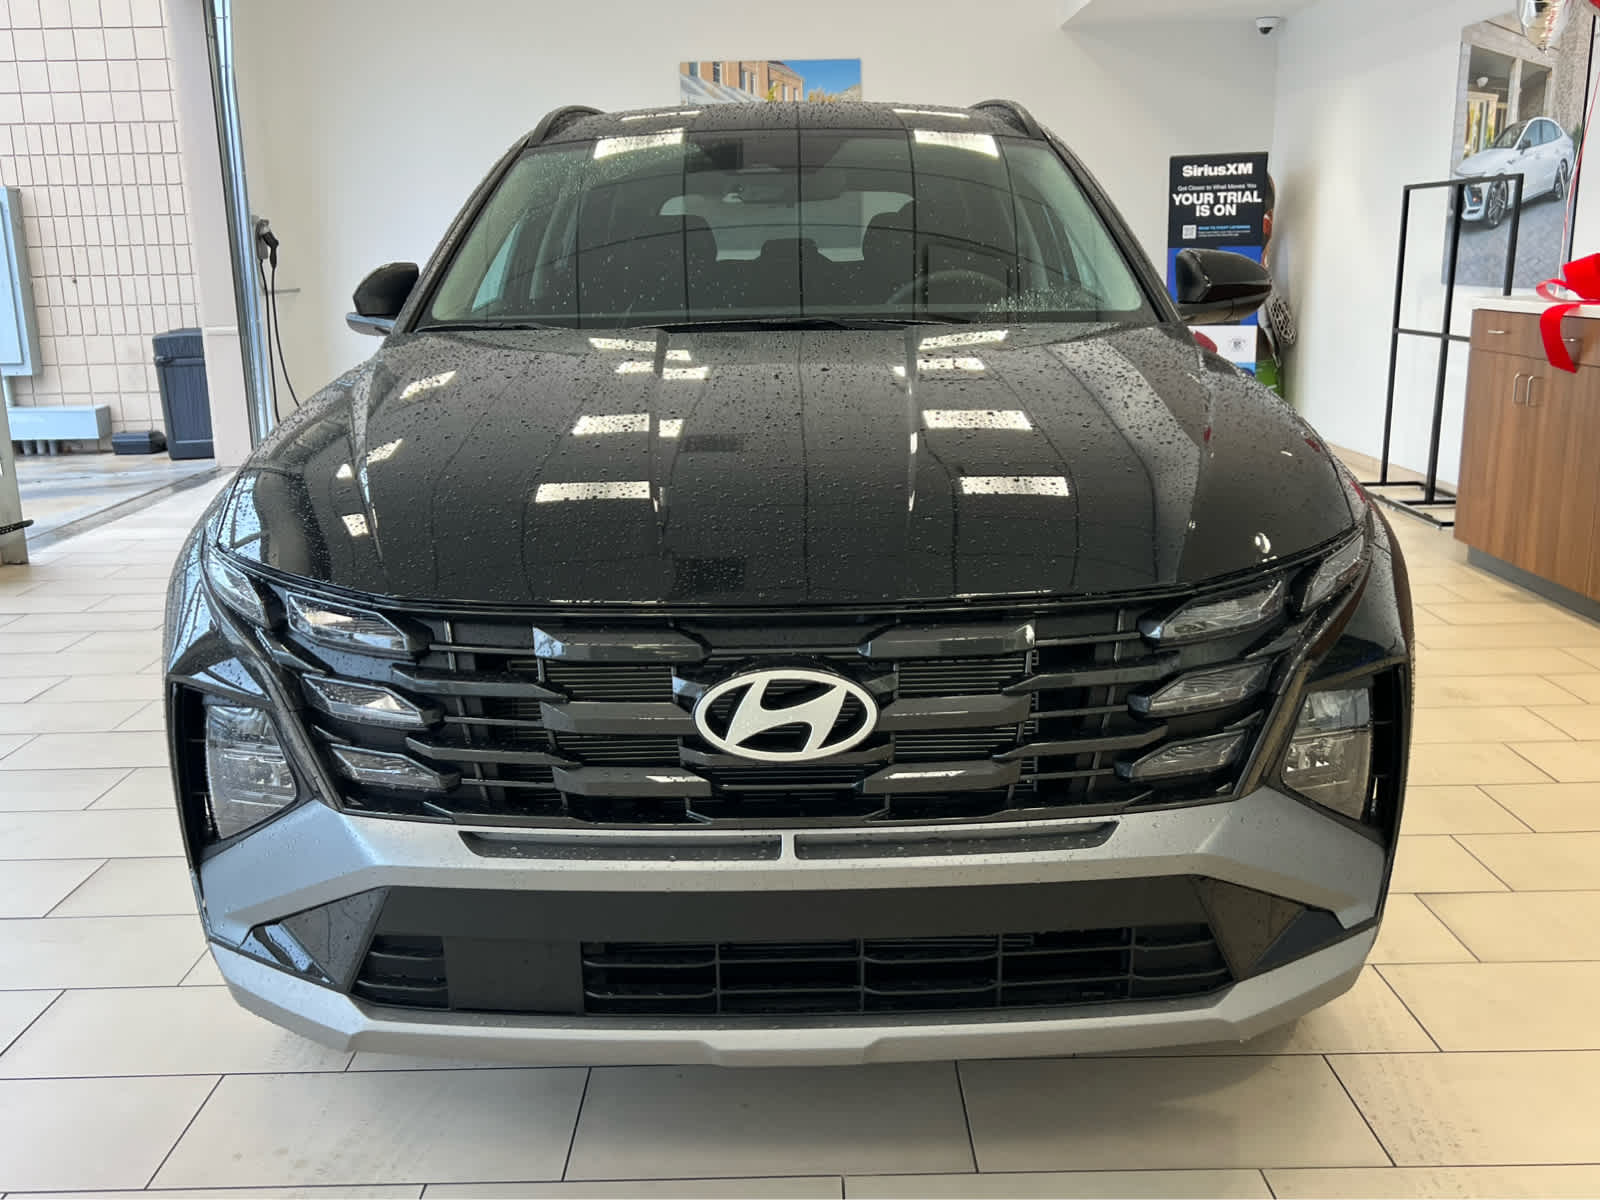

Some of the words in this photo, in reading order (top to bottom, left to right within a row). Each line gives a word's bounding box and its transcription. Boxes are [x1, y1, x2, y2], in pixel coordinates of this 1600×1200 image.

[1182, 162, 1253, 177] SiriusXM
[1172, 192, 1214, 206] YOUR
[1217, 190, 1262, 204] TRIAL
[1196, 204, 1210, 216] IS
[1213, 203, 1237, 216] ON
